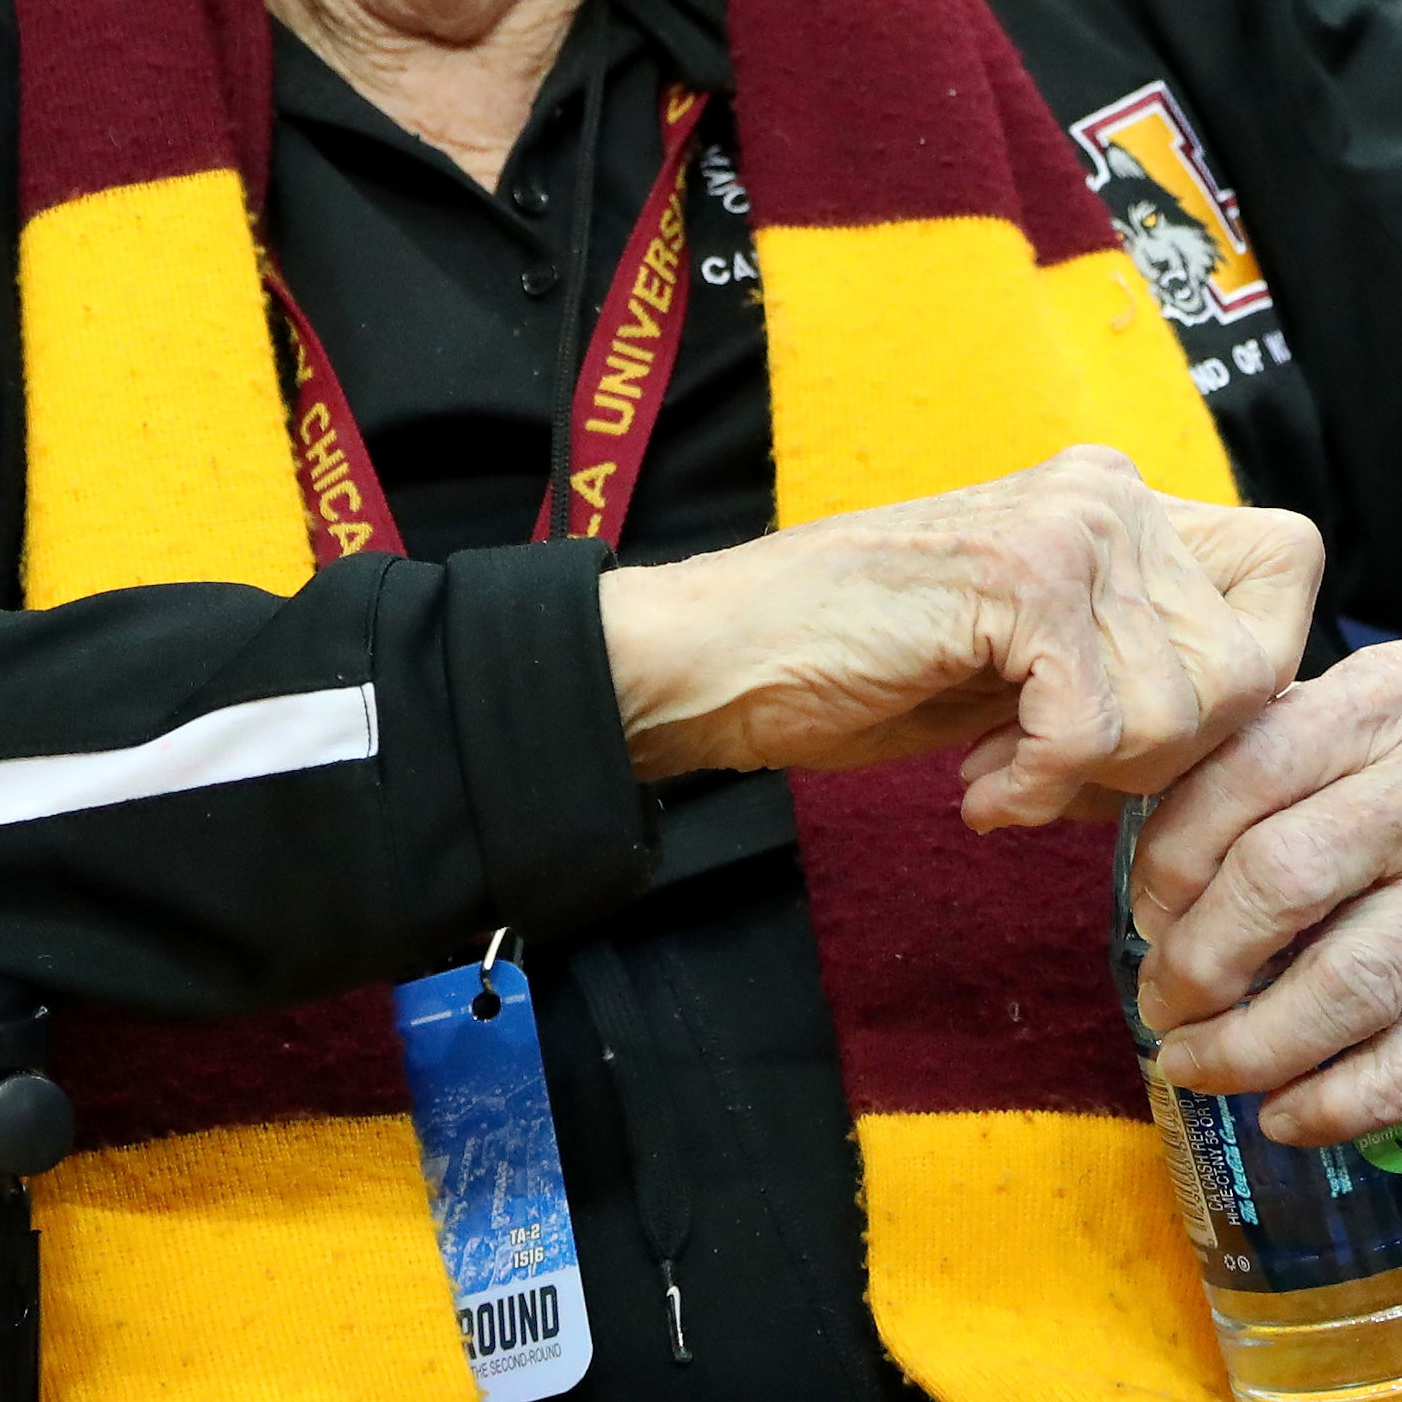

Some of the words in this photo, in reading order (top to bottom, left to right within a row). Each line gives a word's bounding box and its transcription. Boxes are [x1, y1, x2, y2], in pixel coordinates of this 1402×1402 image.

[701, 248, 759, 286] CA
[1179, 1100, 1205, 1150] REFUND
[1198, 1107, 1214, 1128] OR
[1197, 1154, 1217, 1190] CASH
[1209, 1193, 1224, 1212] CA
[1238, 1200, 1259, 1226] The
[510, 1223, 541, 1246] TA-2
[513, 1247, 545, 1269] 1516
[459, 1285, 560, 1360] ROUND
[490, 1343, 562, 1375] SECOND-ROUND
